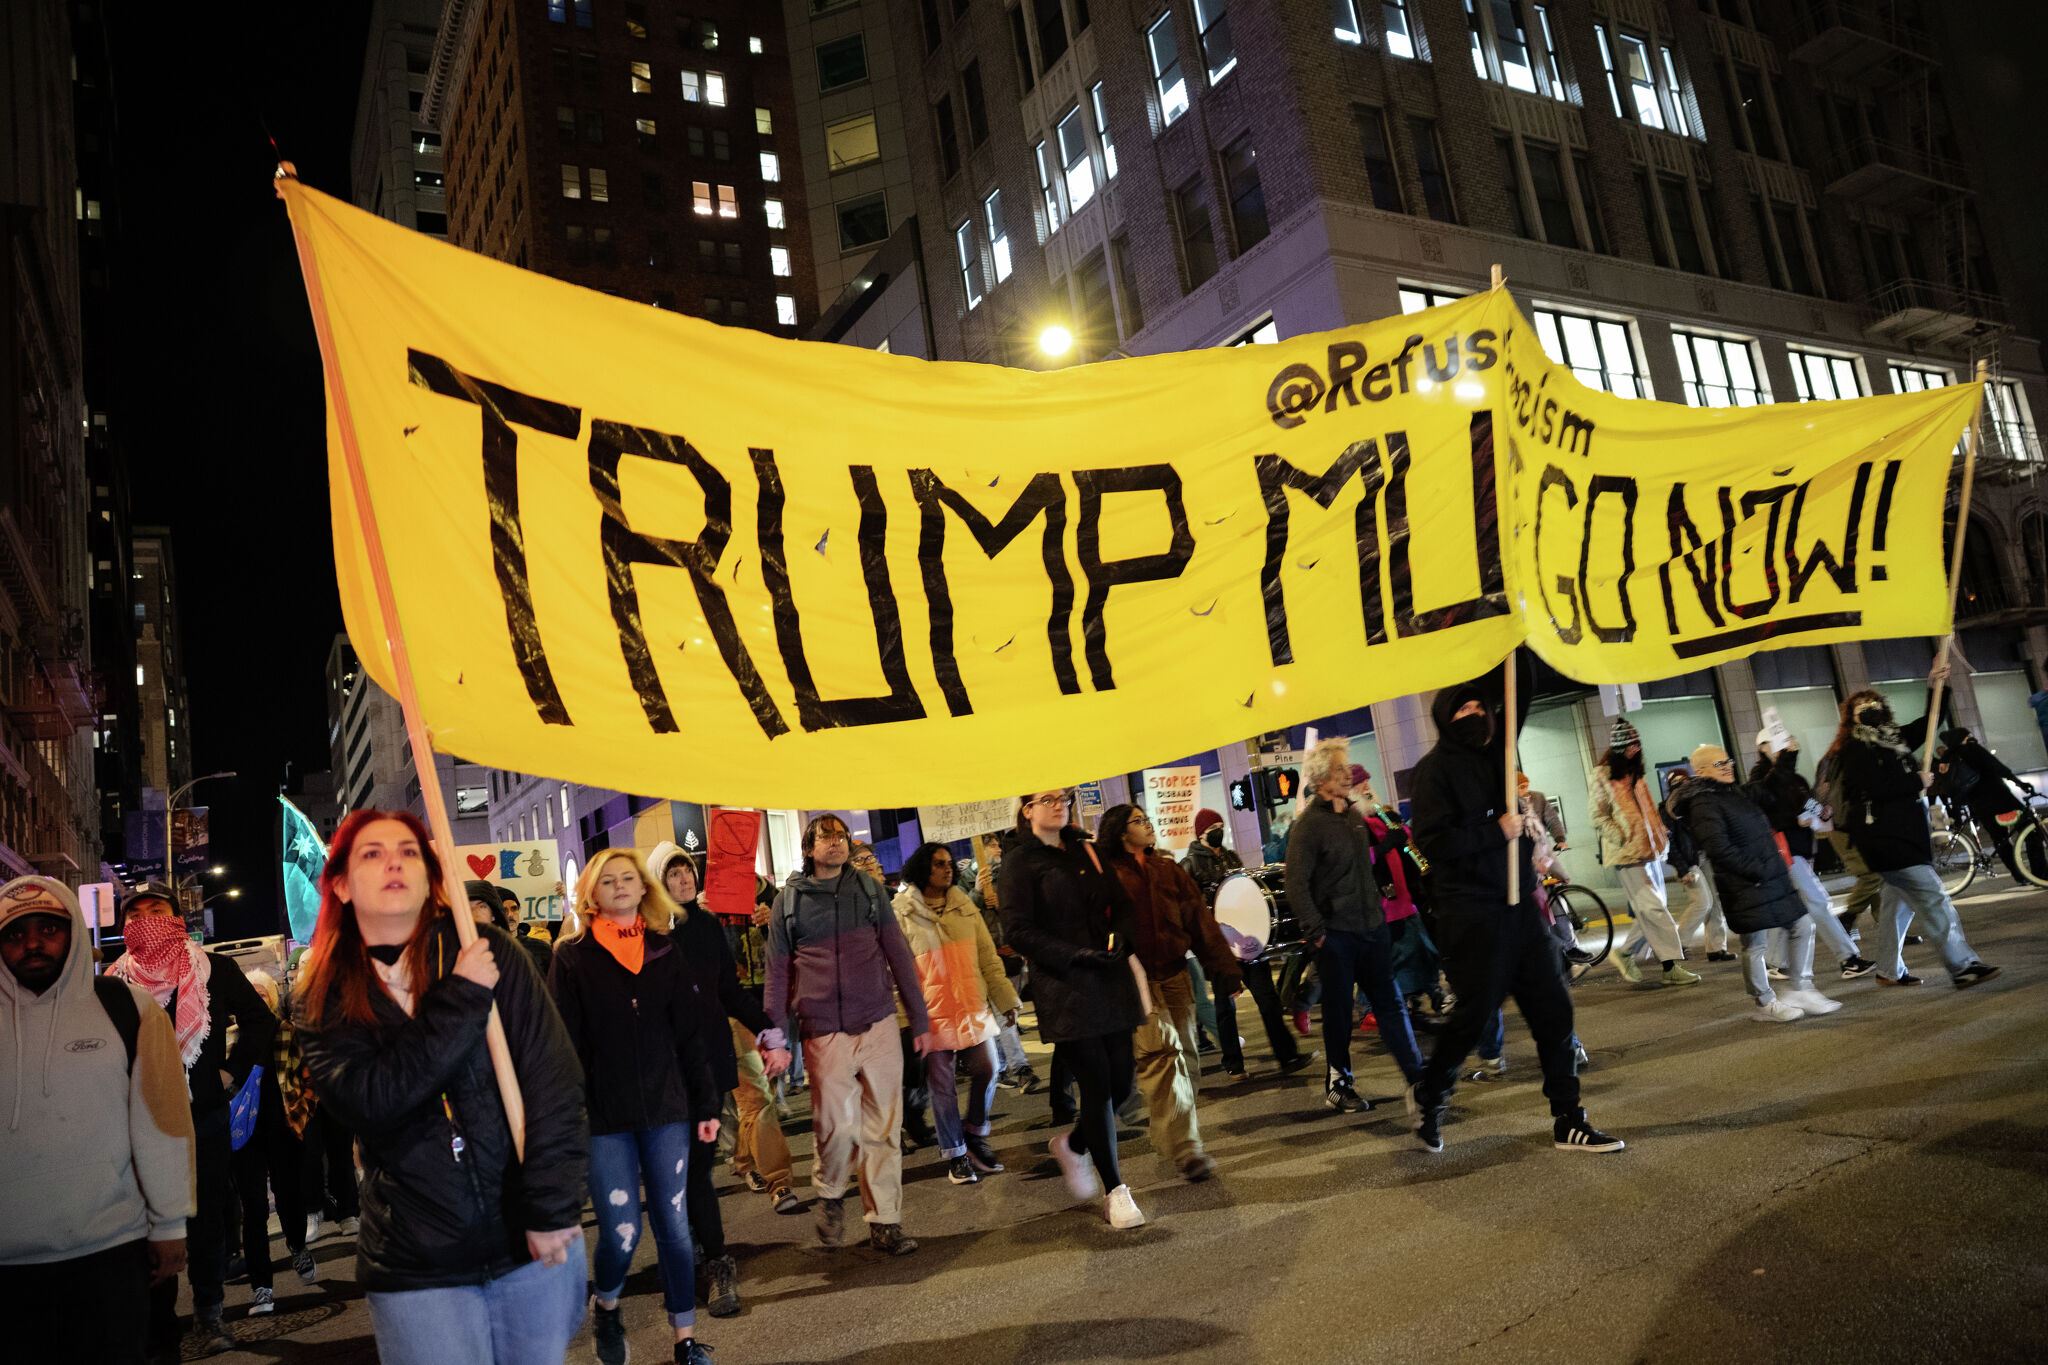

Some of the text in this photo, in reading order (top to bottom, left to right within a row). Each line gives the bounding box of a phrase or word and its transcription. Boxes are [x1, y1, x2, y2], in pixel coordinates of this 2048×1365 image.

[407, 347, 1196, 741] TRUMP
[1254, 408, 1511, 667] MU
[1534, 464, 1637, 645] GO
[1274, 755, 1293, 763] Pine
[1149, 775, 1197, 789] STOP ICE
[1157, 790, 1192, 798] DISBAND
[1155, 804, 1194, 815] IMPEACH
[1158, 816, 1189, 826] REMOVE
[1159, 826, 1194, 837] CONVICT
[523, 895, 562, 920] ICE
[72, 1040, 100, 1051] Ford
